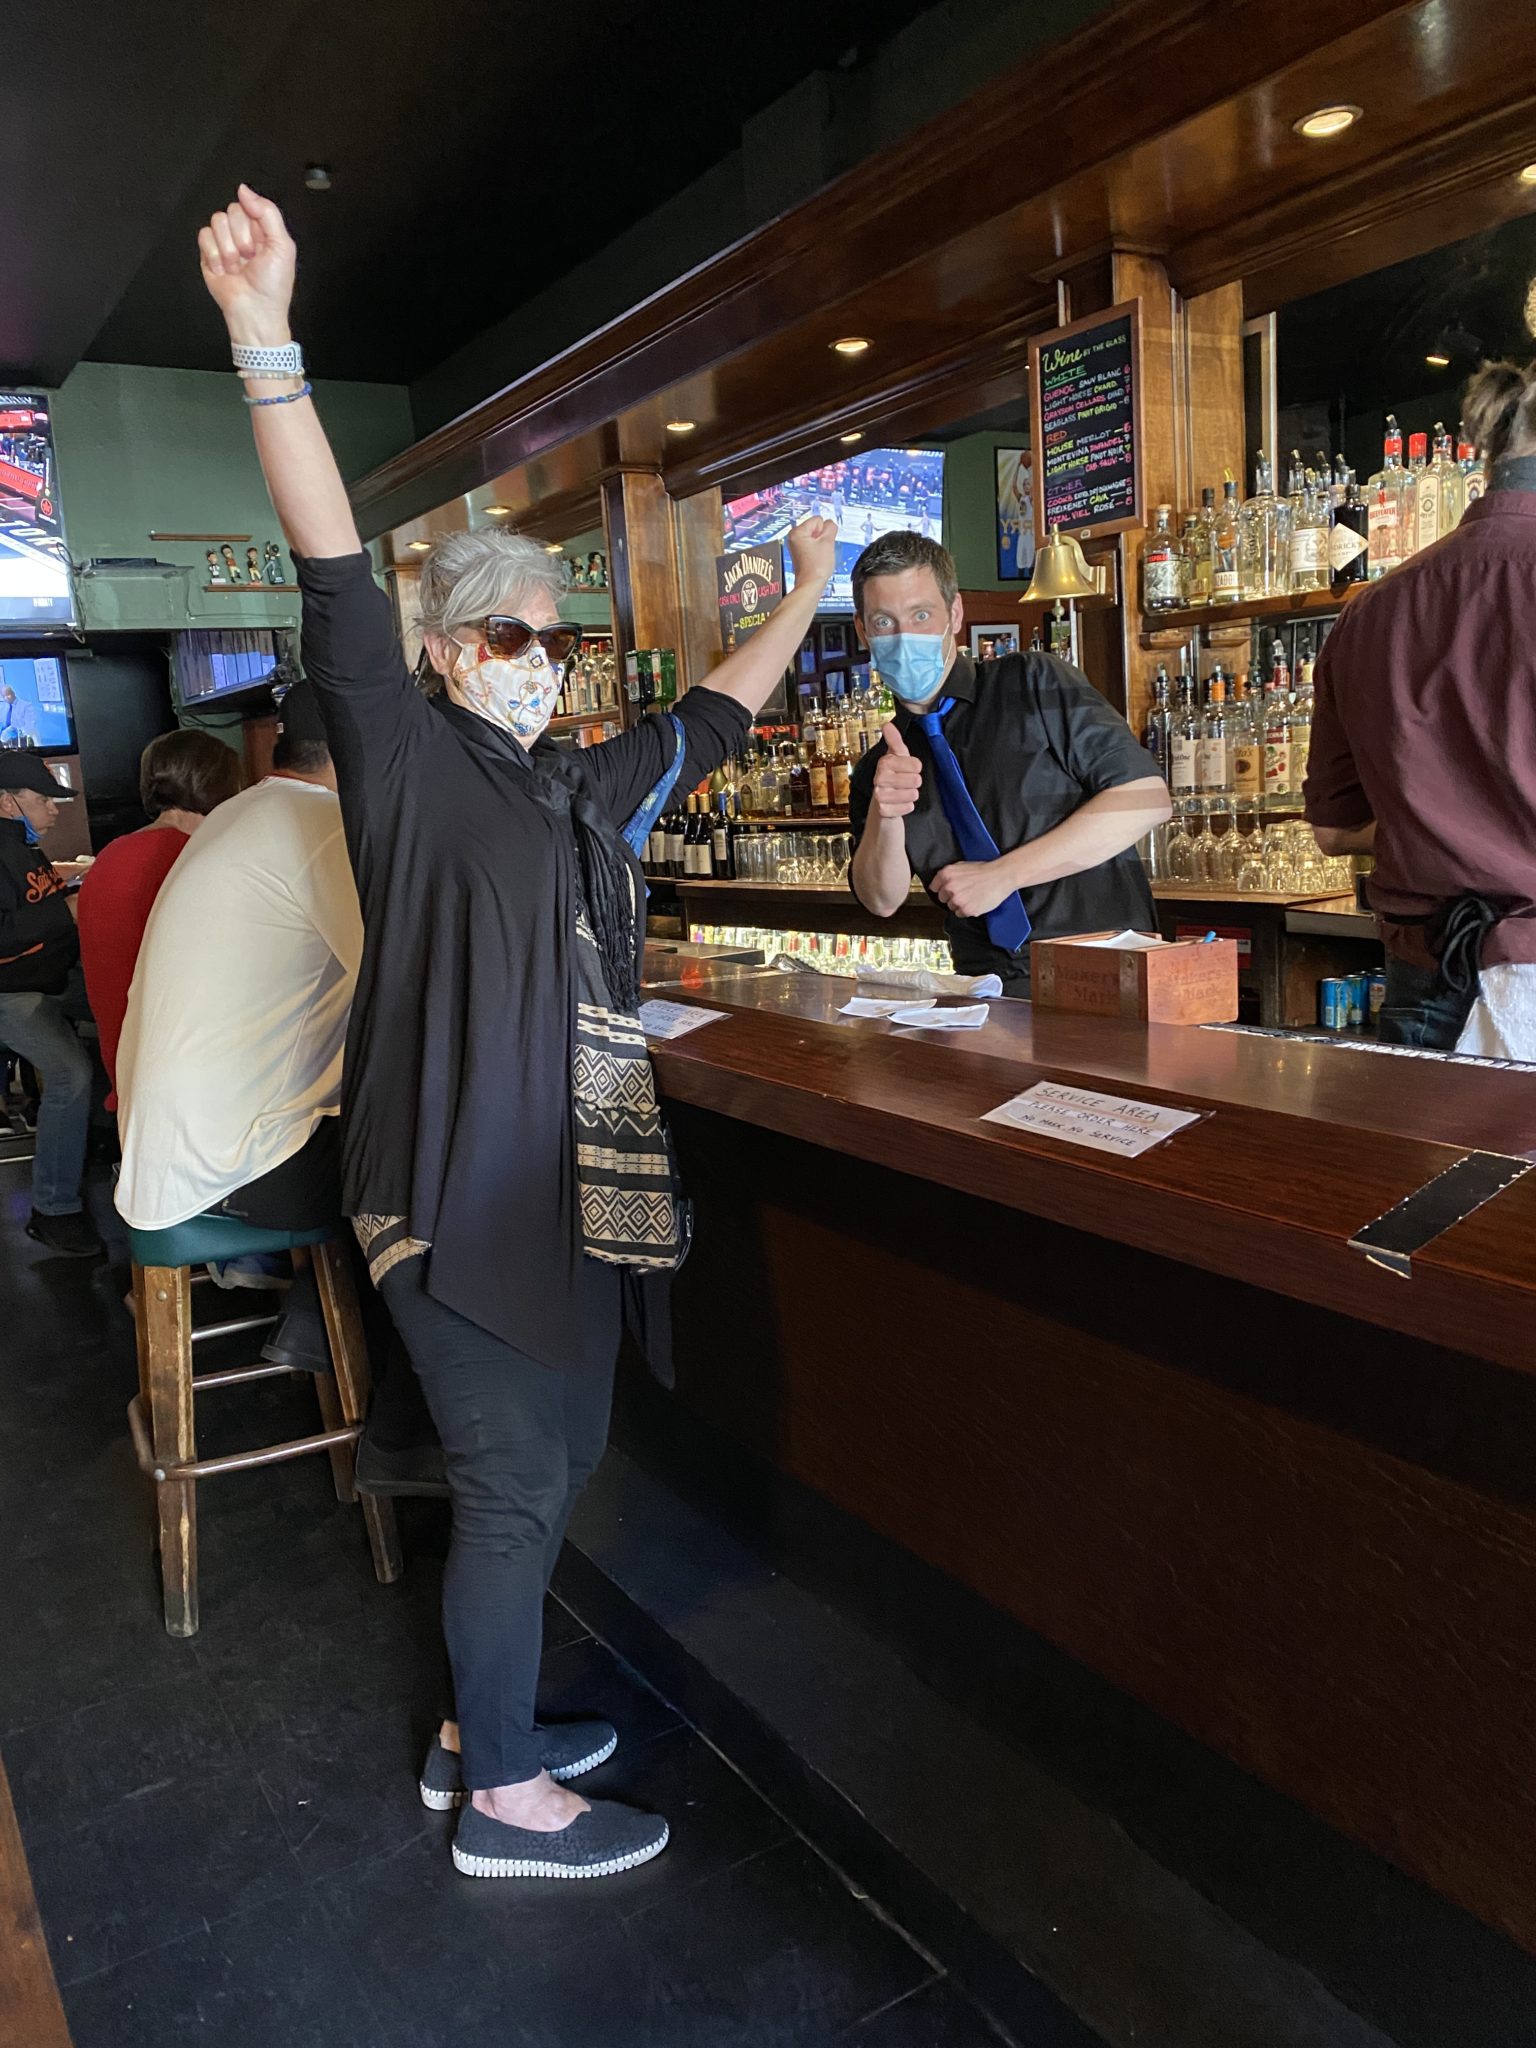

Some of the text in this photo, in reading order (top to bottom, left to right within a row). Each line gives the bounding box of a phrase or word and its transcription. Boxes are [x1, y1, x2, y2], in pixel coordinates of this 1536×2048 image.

[1042, 349, 1083, 373] Wine
[1093, 342, 1105, 352] THE
[1105, 334, 1126, 348] GLASS
[1045, 365, 1086, 386] WHITE
[1097, 368, 1122, 381] BLANC
[1094, 403, 1117, 415] GRIGIO
[1046, 430, 1067, 444] RED
[1047, 440, 1074, 457] HOUSE
[1047, 479, 1083, 496] OTHER
[1089, 493, 1109, 504] CAVA
[1369, 507, 1396, 520] BEEFEATER
[723, 561, 743, 593] JACK
[1035, 1086, 1160, 1123] SERVICE AREA
[1029, 1101, 1153, 1136] PLEASE ORDER HERE
[1022, 1114, 1035, 1123] NO
[1071, 1126, 1083, 1134] NO
[1090, 1131, 1136, 1147] SERVICE
